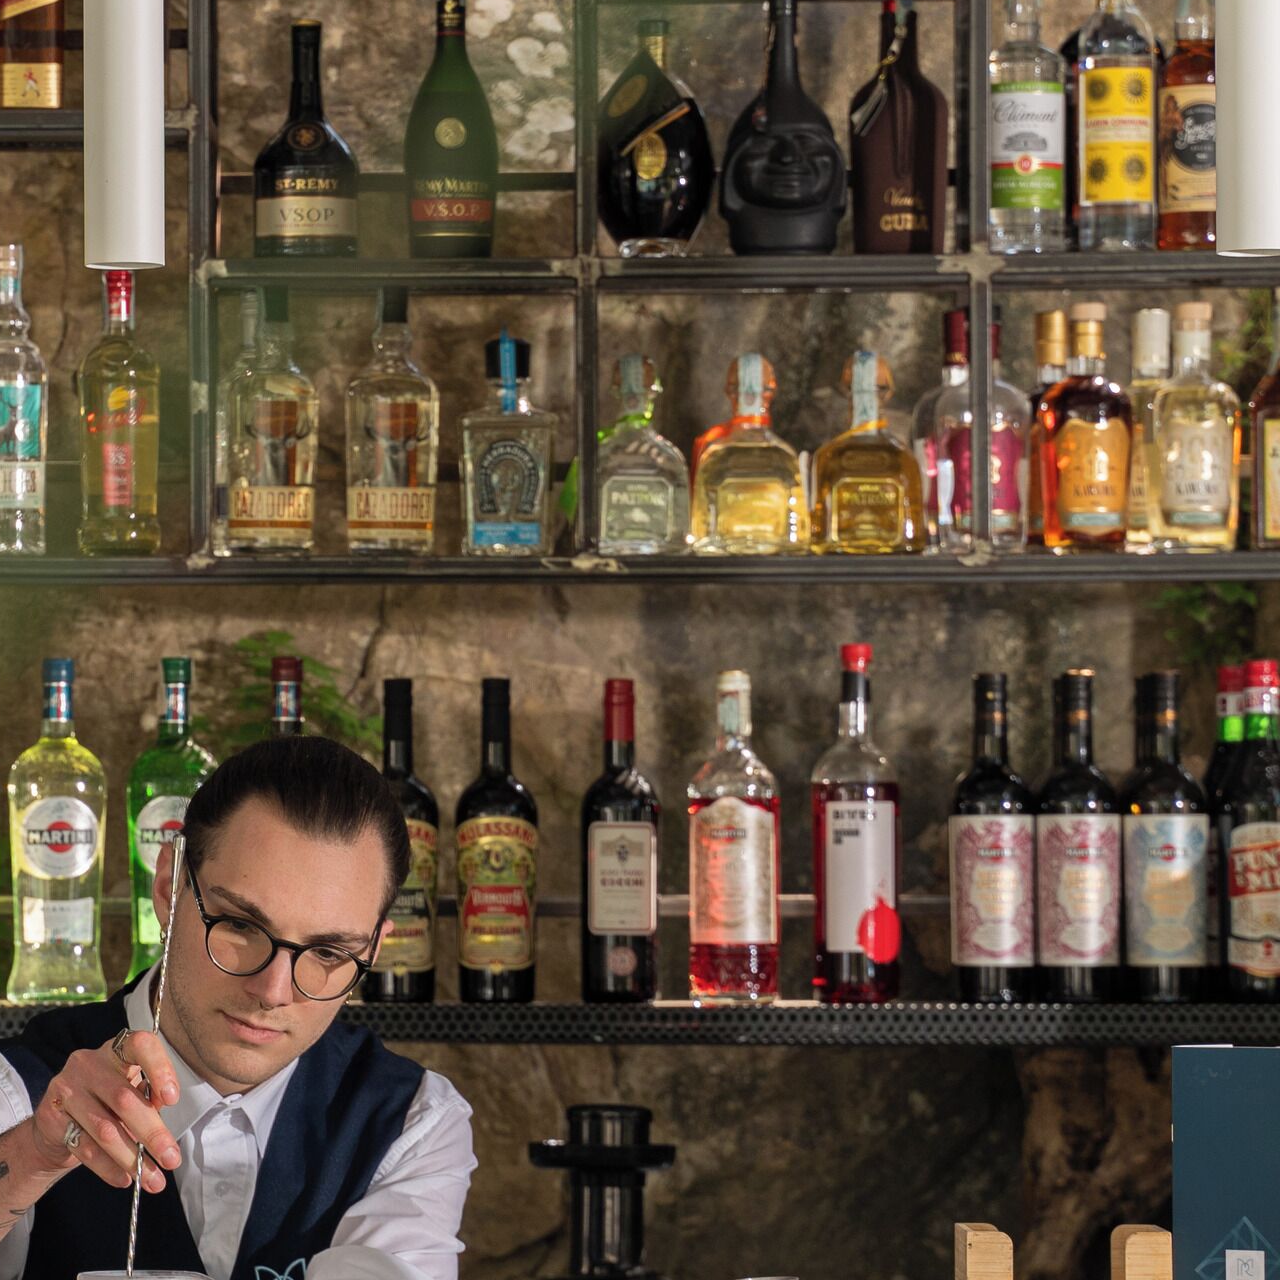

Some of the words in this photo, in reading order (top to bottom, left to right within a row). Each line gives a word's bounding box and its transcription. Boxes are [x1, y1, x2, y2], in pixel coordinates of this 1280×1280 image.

[279, 207, 335, 223] VSOP
[232, 489, 311, 519] CAZADORES
[356, 491, 432, 520] CAZADORES
[28, 828, 93, 845] MARTINI
[459, 820, 535, 844] MULASSANO
